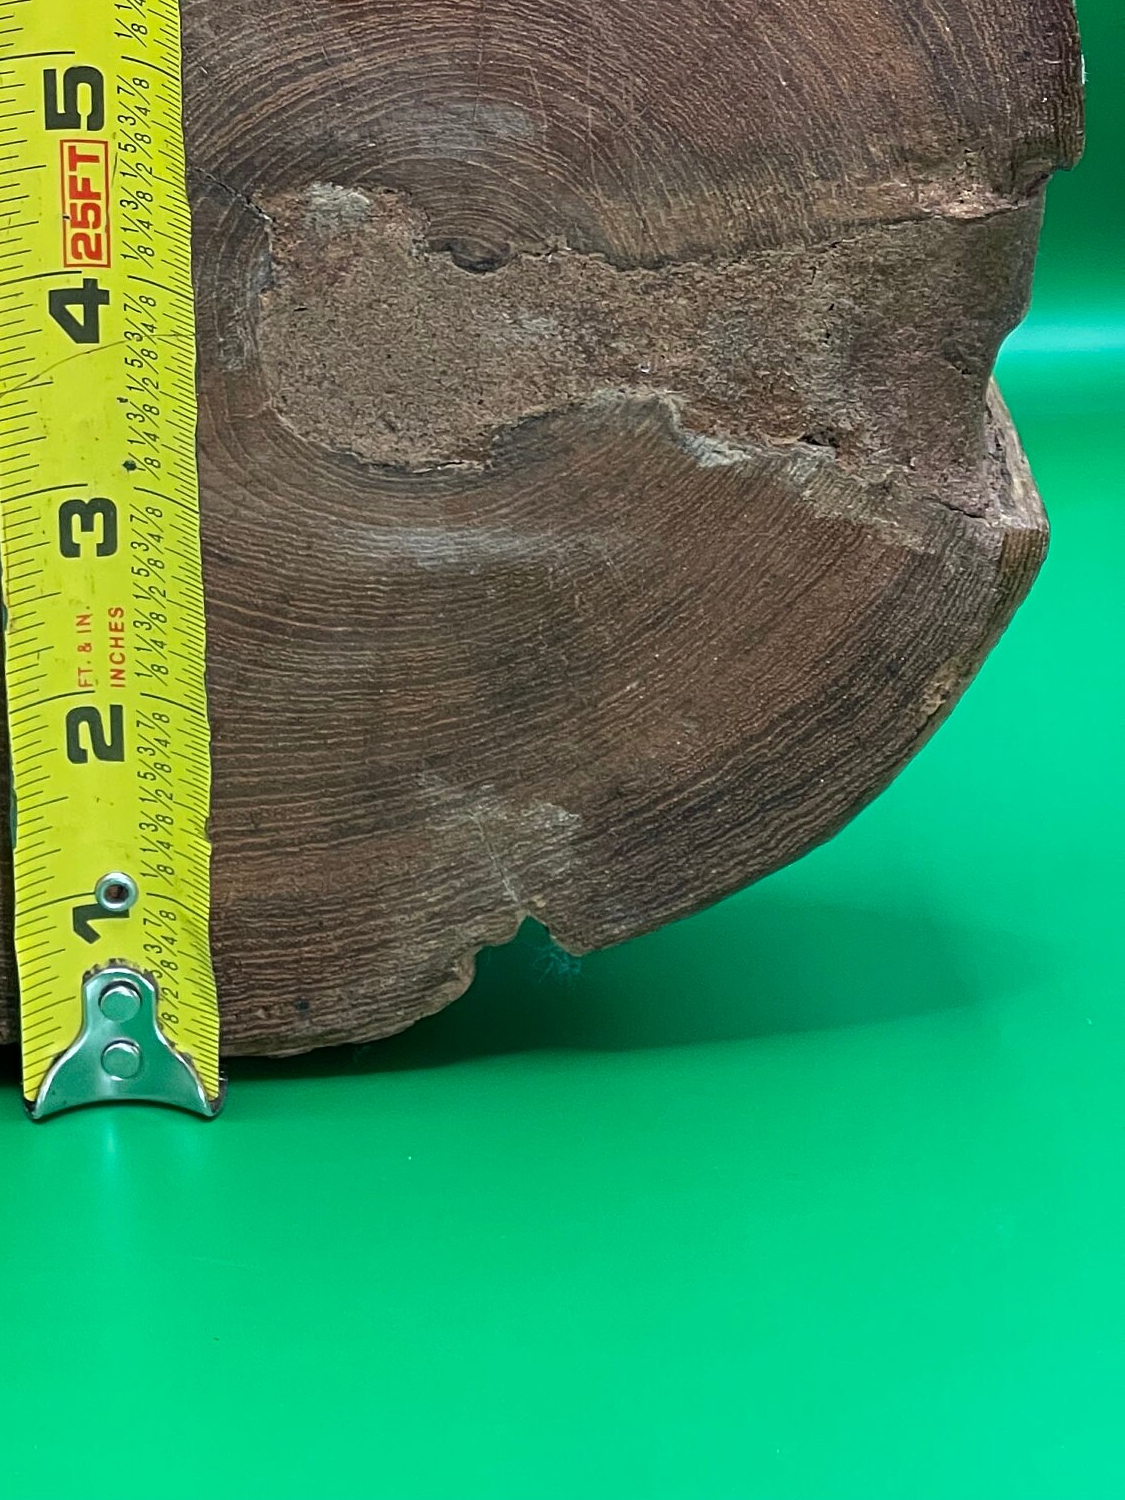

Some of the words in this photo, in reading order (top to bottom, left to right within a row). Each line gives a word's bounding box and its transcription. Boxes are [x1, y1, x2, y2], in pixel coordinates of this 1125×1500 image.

[113, 17, 147, 47] 1/8
[43, 66, 105, 131] 5
[116, 74, 150, 105] 7/8
[116, 100, 150, 129] 3/4
[117, 128, 153, 159] 5/8
[118, 158, 153, 187] 1/2
[68, 145, 103, 261] 25FT
[119, 186, 153, 215] 3/8
[119, 212, 153, 241] 1/4
[119, 240, 155, 269] 1/8
[48, 278, 110, 344] 4
[122, 292, 157, 322] 7/8
[123, 317, 160, 345] 3/4
[124, 344, 159, 374] 5/8
[125, 373, 159, 401] 1/2
[125, 400, 159, 428] 3/8
[126, 425, 159, 453] 1/4
[59, 497, 118, 559] 3
[129, 503, 163, 532] 7/8
[130, 528, 163, 554] 3/4
[130, 554, 165, 583] 5/8
[132, 581, 166, 609] 1/2
[76, 606, 92, 634] IN.
[132, 607, 167, 635] 3/8
[77, 642, 92, 653] &
[108, 606, 126, 688] INCHES
[133, 633, 167, 660] 1/4
[77, 660, 93, 688] FT.
[133, 659, 168, 686] 1/8
[65, 704, 125, 764] 2
[135, 709, 170, 738] 7/8
[136, 733, 170, 758] 3/4
[136, 758, 172, 786] 5/8
[138, 785, 173, 811] 1/2
[138, 810, 173, 836] 3/8
[138, 834, 173, 860] 1/4
[139, 859, 174, 886] 1/8
[72, 902, 130, 944] 1
[142, 907, 177, 935] 7/8
[142, 931, 177, 956] 3/4
